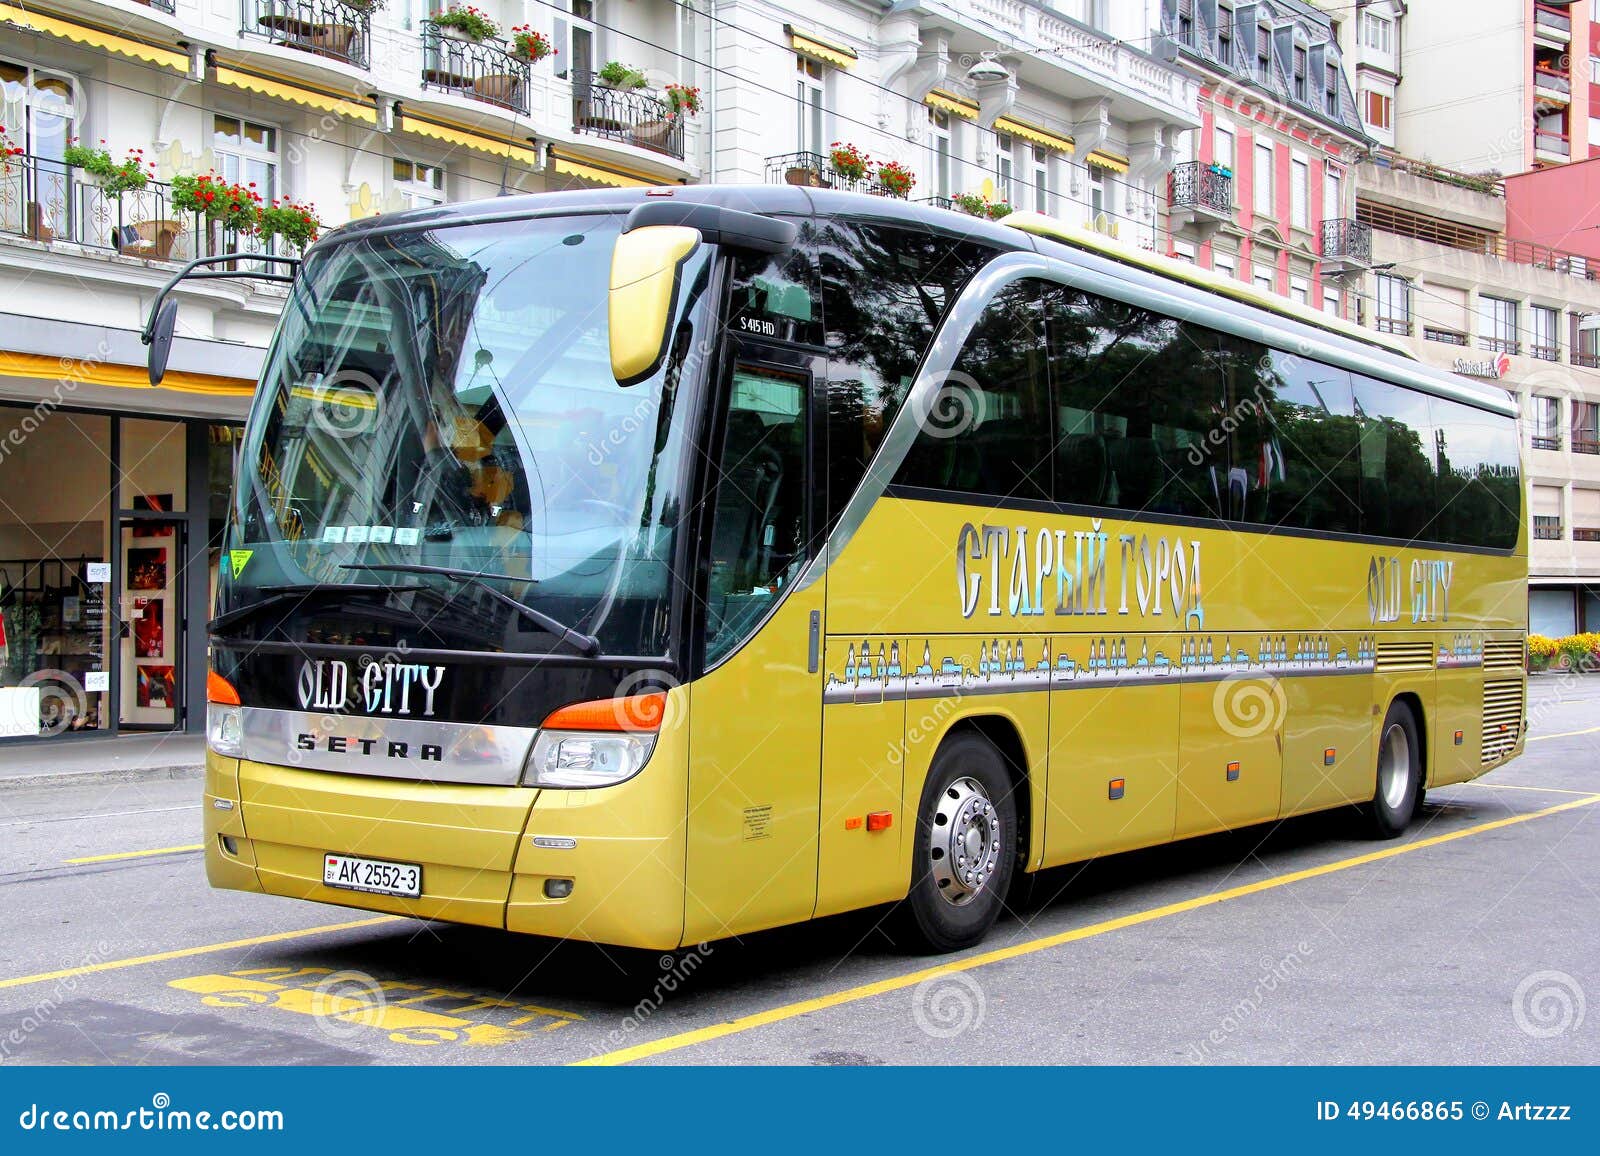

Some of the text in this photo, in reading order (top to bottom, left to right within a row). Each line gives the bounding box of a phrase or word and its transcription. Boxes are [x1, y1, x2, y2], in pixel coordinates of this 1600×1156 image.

[741, 316, 775, 336] S 415 HD
[957, 518, 1204, 631] СТАРЫЙ ГОРОД
[1368, 555, 1453, 626] OLD CITY
[298, 659, 446, 717] OLD CITY
[297, 733, 442, 762] SETRA
[338, 860, 361, 884] AK
[364, 863, 417, 891] 2552-3
